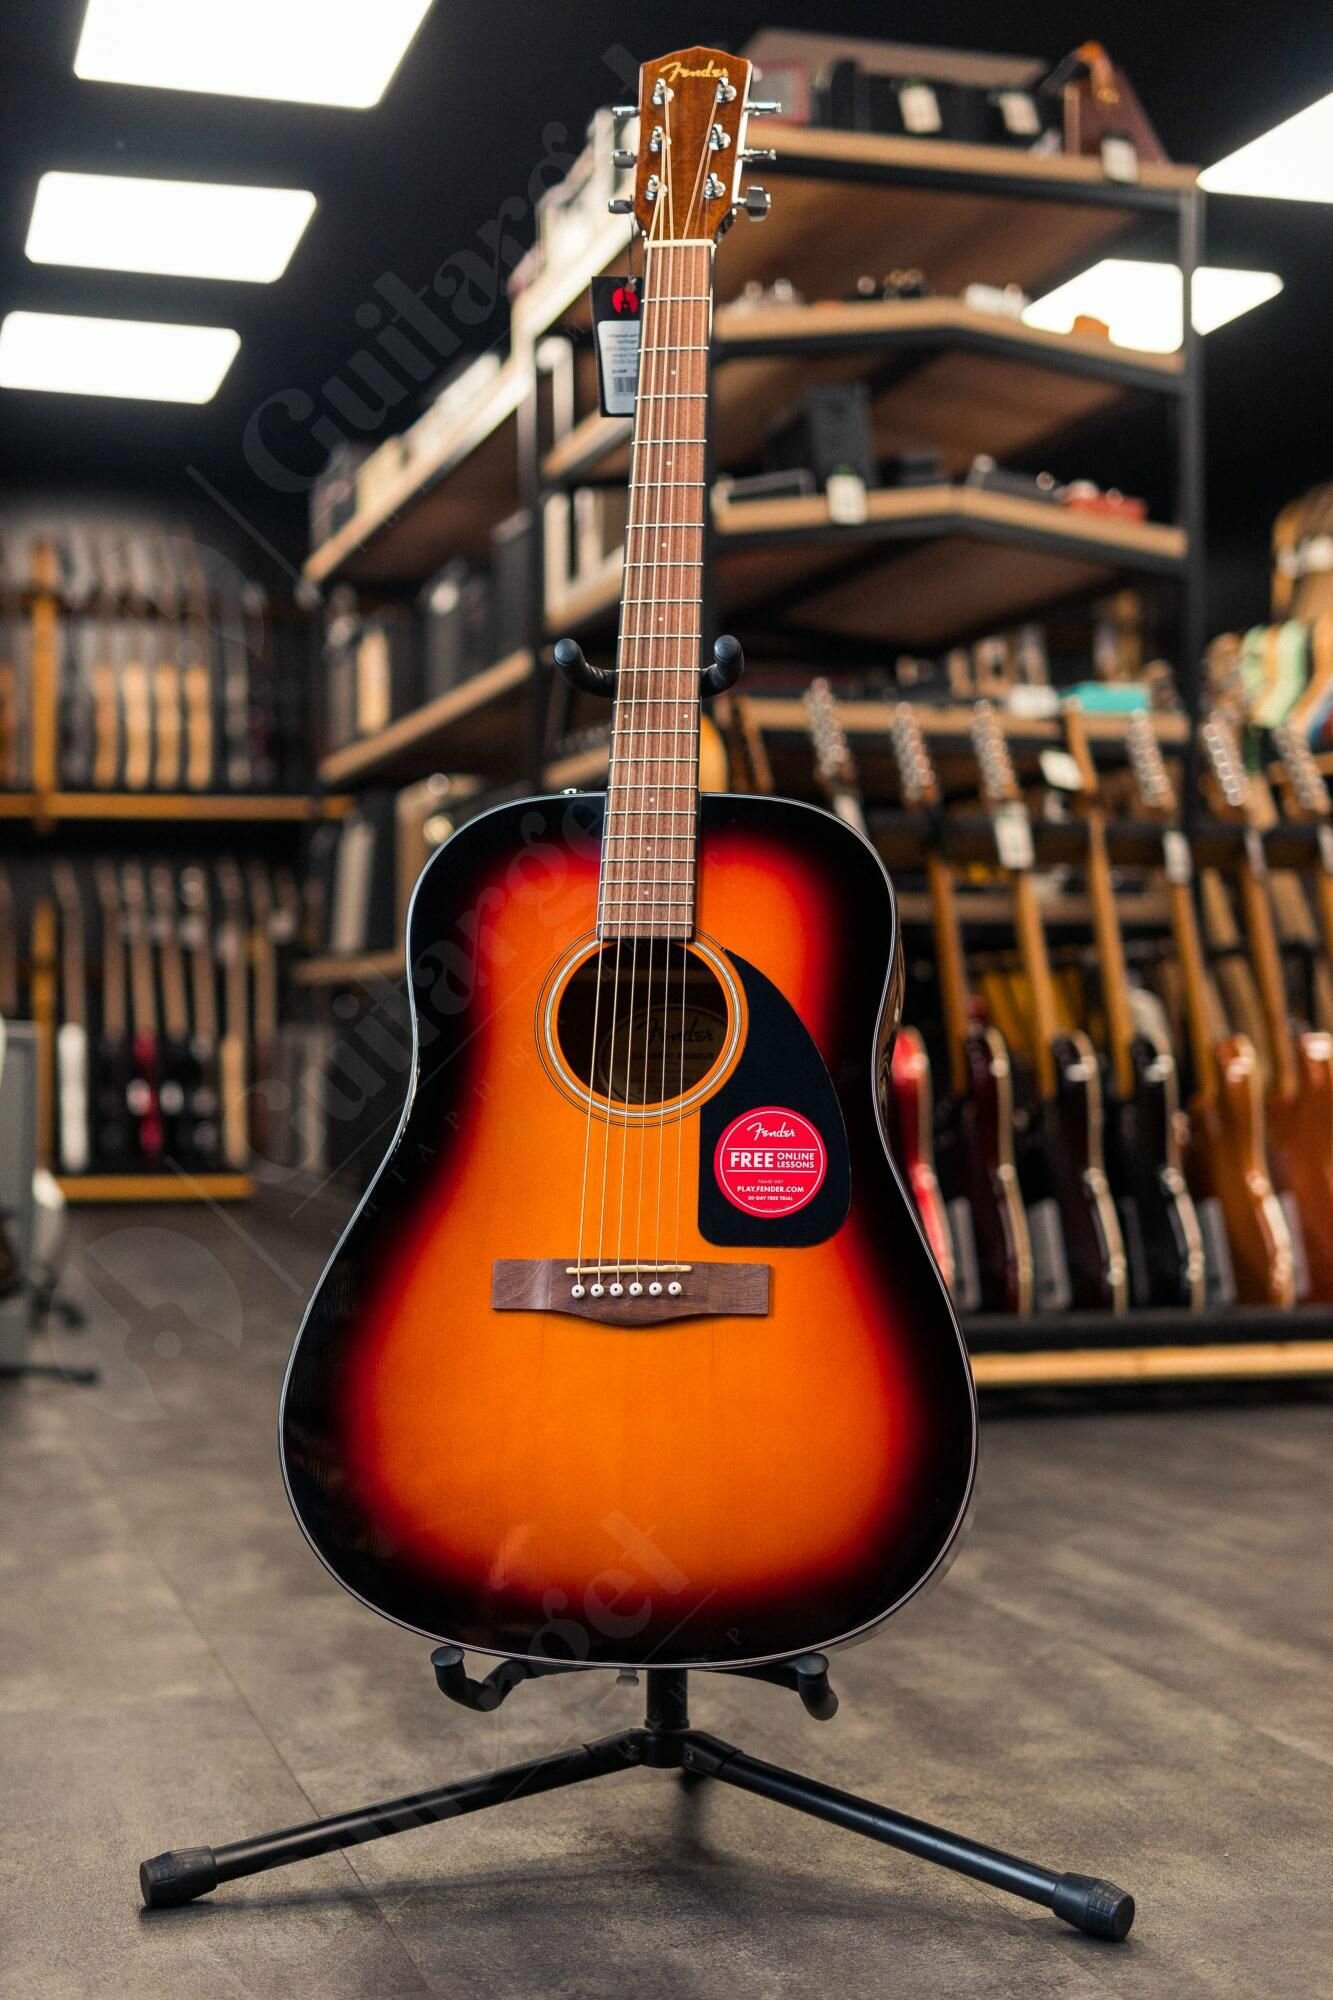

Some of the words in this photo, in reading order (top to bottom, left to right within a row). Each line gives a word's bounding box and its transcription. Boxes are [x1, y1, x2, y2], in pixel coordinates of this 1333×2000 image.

[659, 60, 729, 82] Fender
[746, 1121, 796, 1141] Fender
[730, 1151, 774, 1168] FREE
[776, 1152, 815, 1161] ONLINE
[776, 1160, 815, 1169] LESSONS
[736, 1185, 804, 1193] PLAY.FENDER.COM
